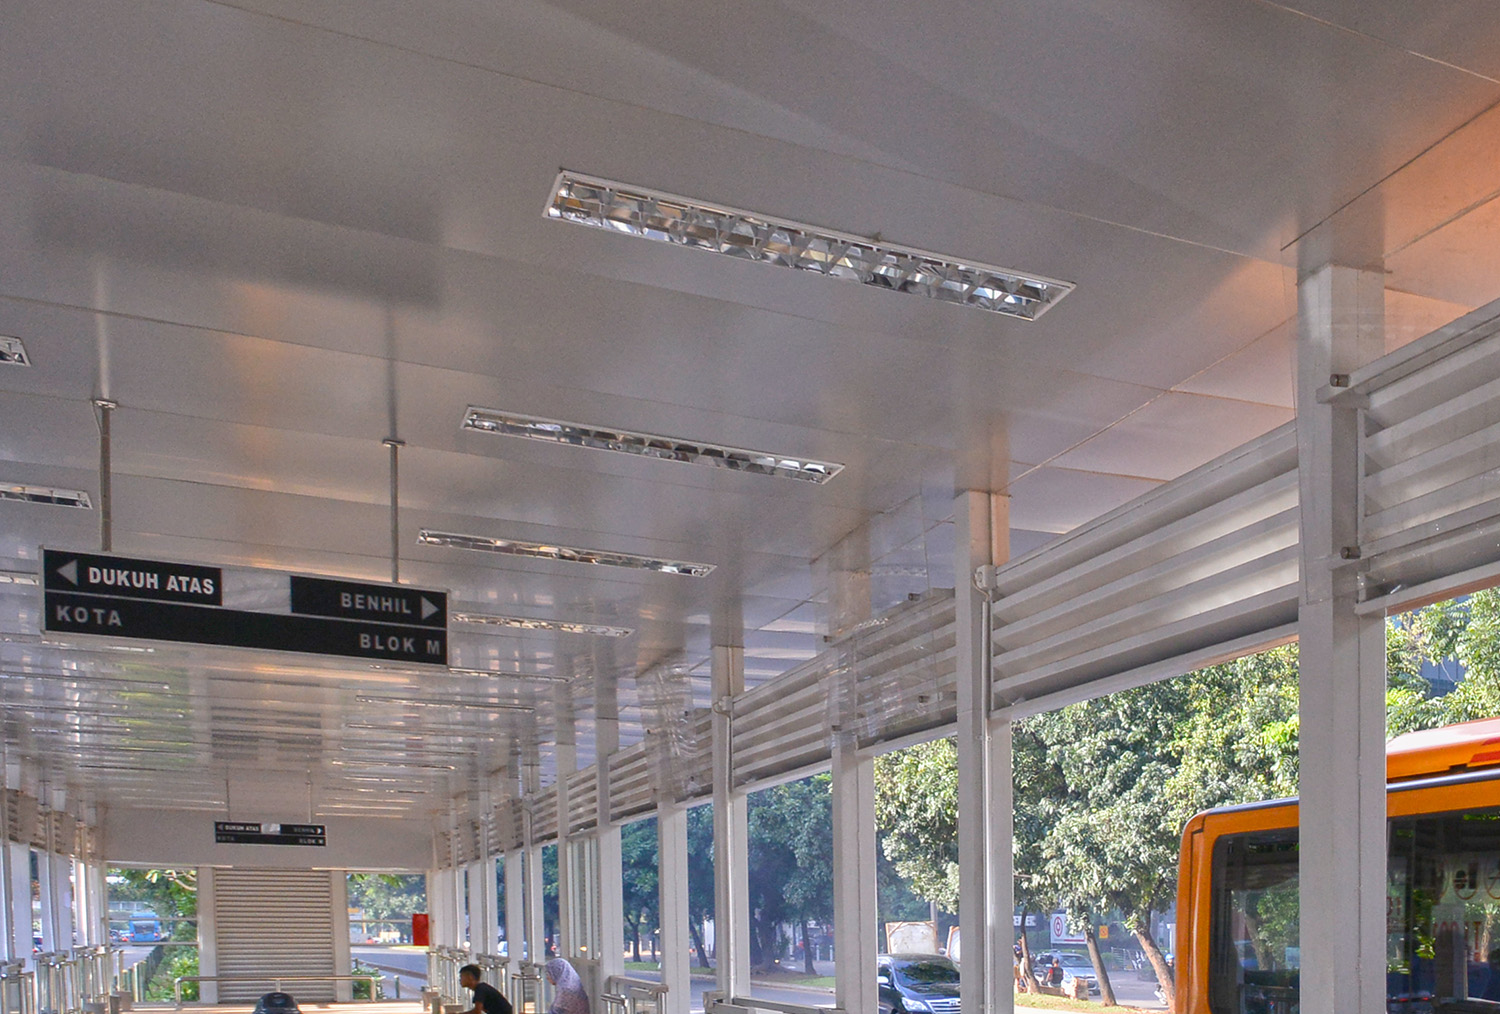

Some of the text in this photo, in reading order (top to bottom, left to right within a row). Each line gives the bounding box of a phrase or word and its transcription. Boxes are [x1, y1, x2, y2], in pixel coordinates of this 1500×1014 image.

[88, 566, 215, 595] DUKUH ATAS
[341, 592, 412, 614] BENHIL
[56, 604, 122, 627] KOTA
[360, 633, 440, 655] BLOK M
